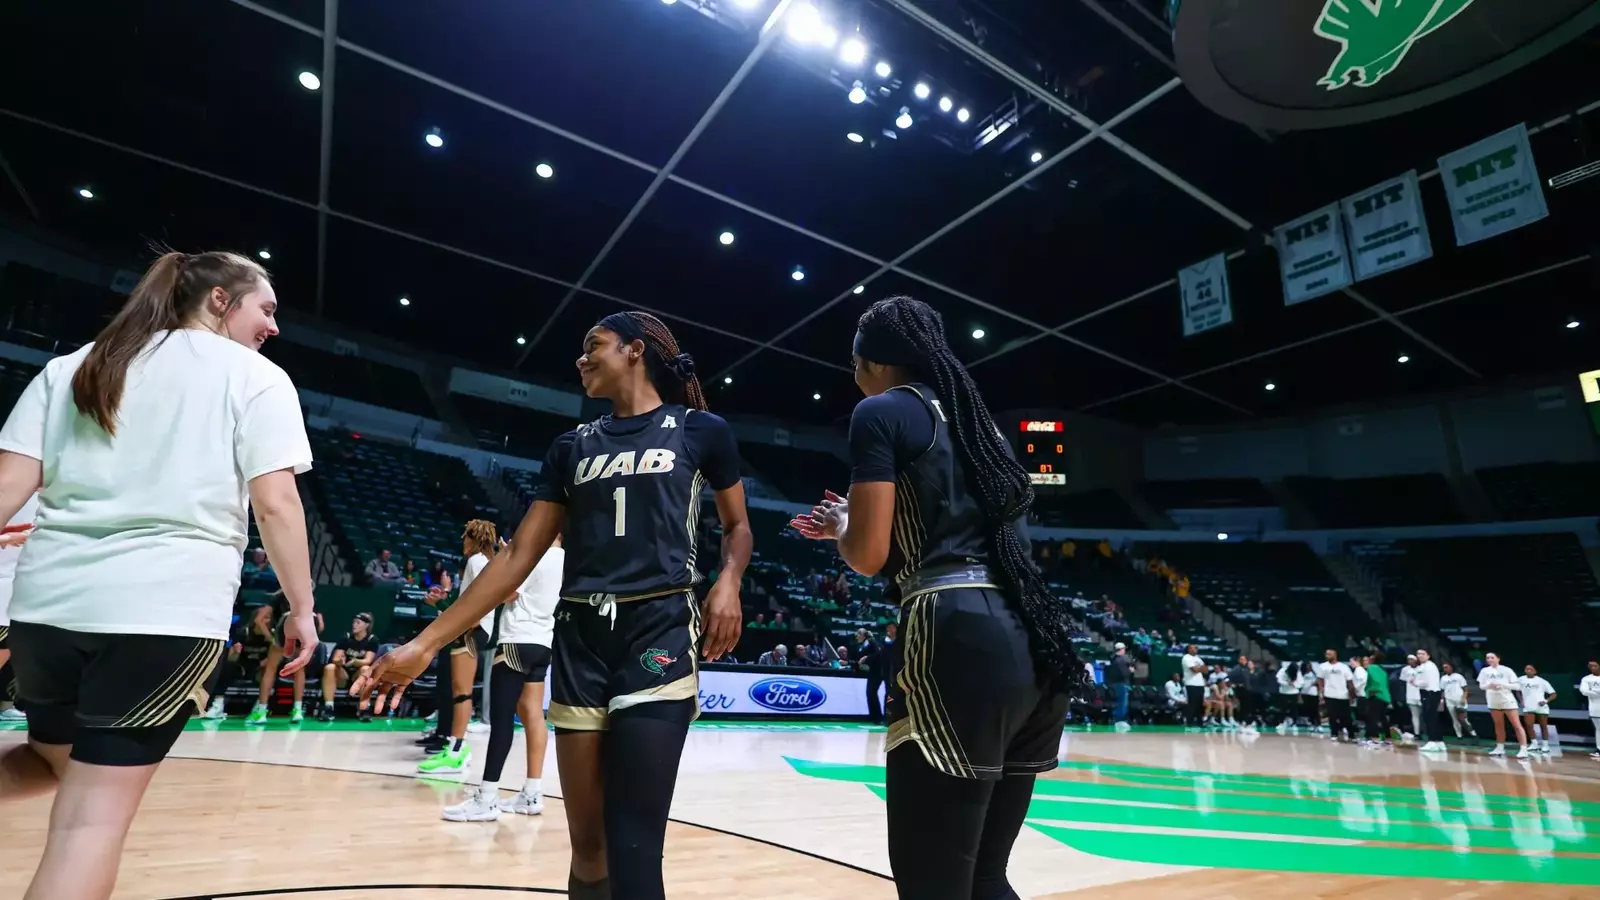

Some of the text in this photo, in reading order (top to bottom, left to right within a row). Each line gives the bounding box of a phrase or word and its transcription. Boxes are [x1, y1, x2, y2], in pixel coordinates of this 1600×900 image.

[1453, 145, 1518, 187] NIT
[1354, 183, 1404, 218] NIT
[1285, 214, 1329, 245] NIT
[574, 448, 676, 485] UAB
[613, 487, 626, 536] 1
[765, 682, 811, 706] Ford
